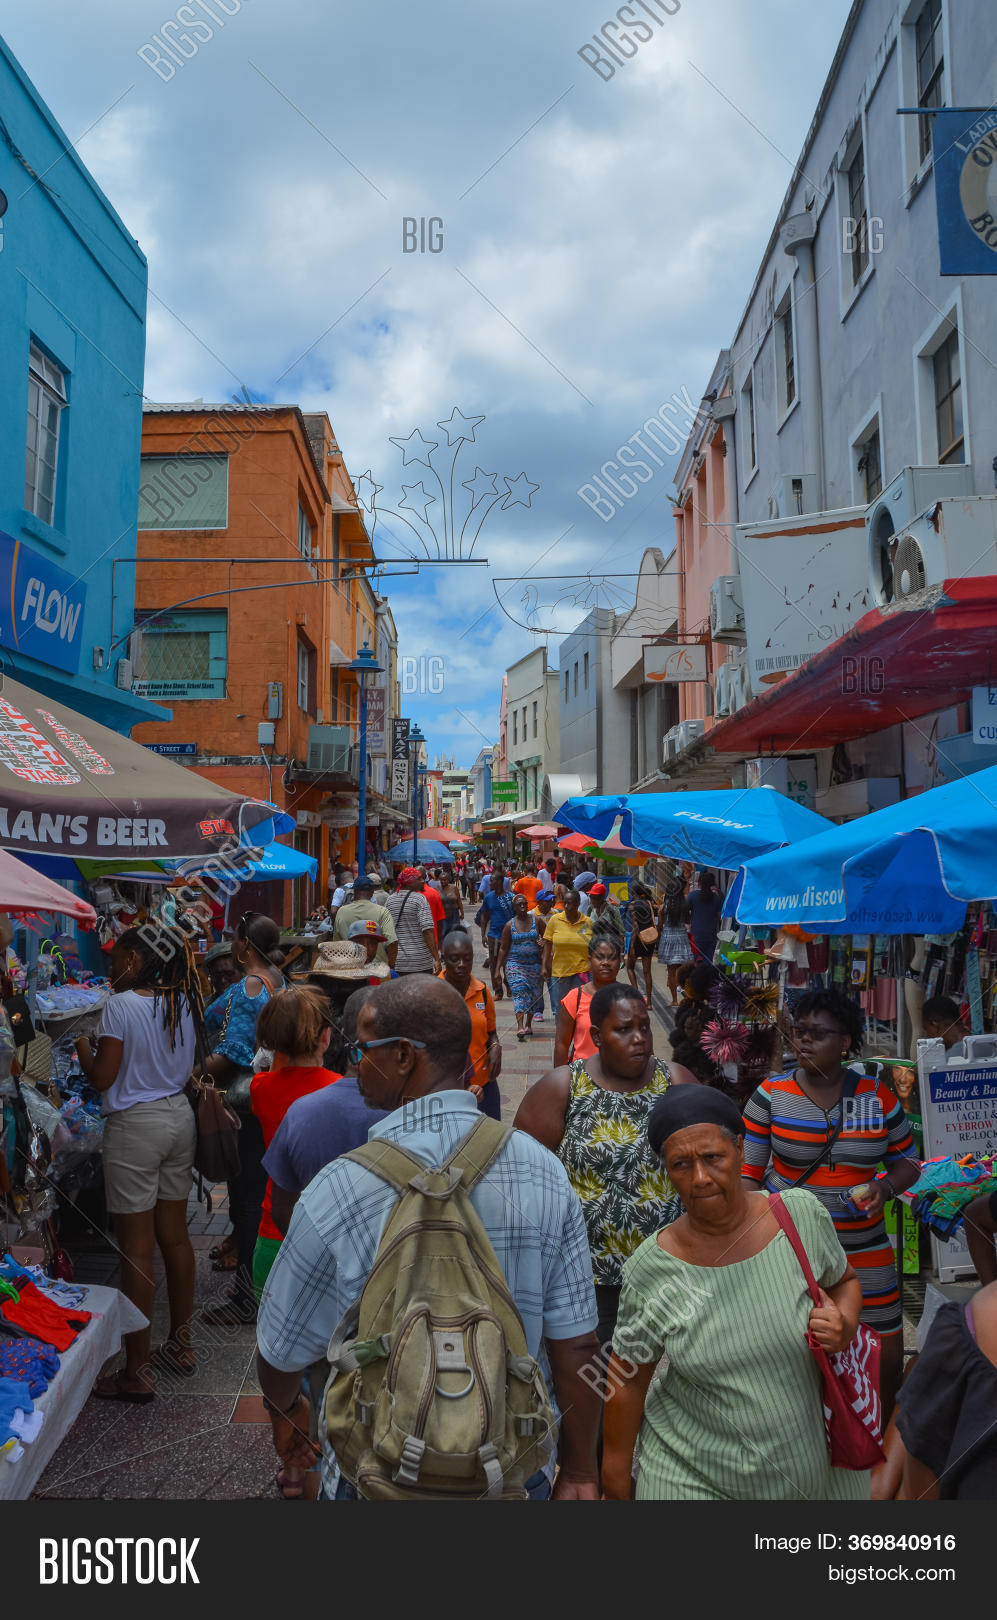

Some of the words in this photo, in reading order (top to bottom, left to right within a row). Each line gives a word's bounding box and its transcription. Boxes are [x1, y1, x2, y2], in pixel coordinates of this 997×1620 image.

[21, 577, 81, 643] FLOW
[673, 811, 754, 829] FLOW
[97, 816, 168, 846] BEER
[935, 1088, 969, 1100] Beauty
[971, 1084, 979, 1096] &
[938, 1102, 962, 1113] HAIR
[964, 1101, 989, 1111] CUTS
[945, 1120, 993, 1133] EYEBROW
